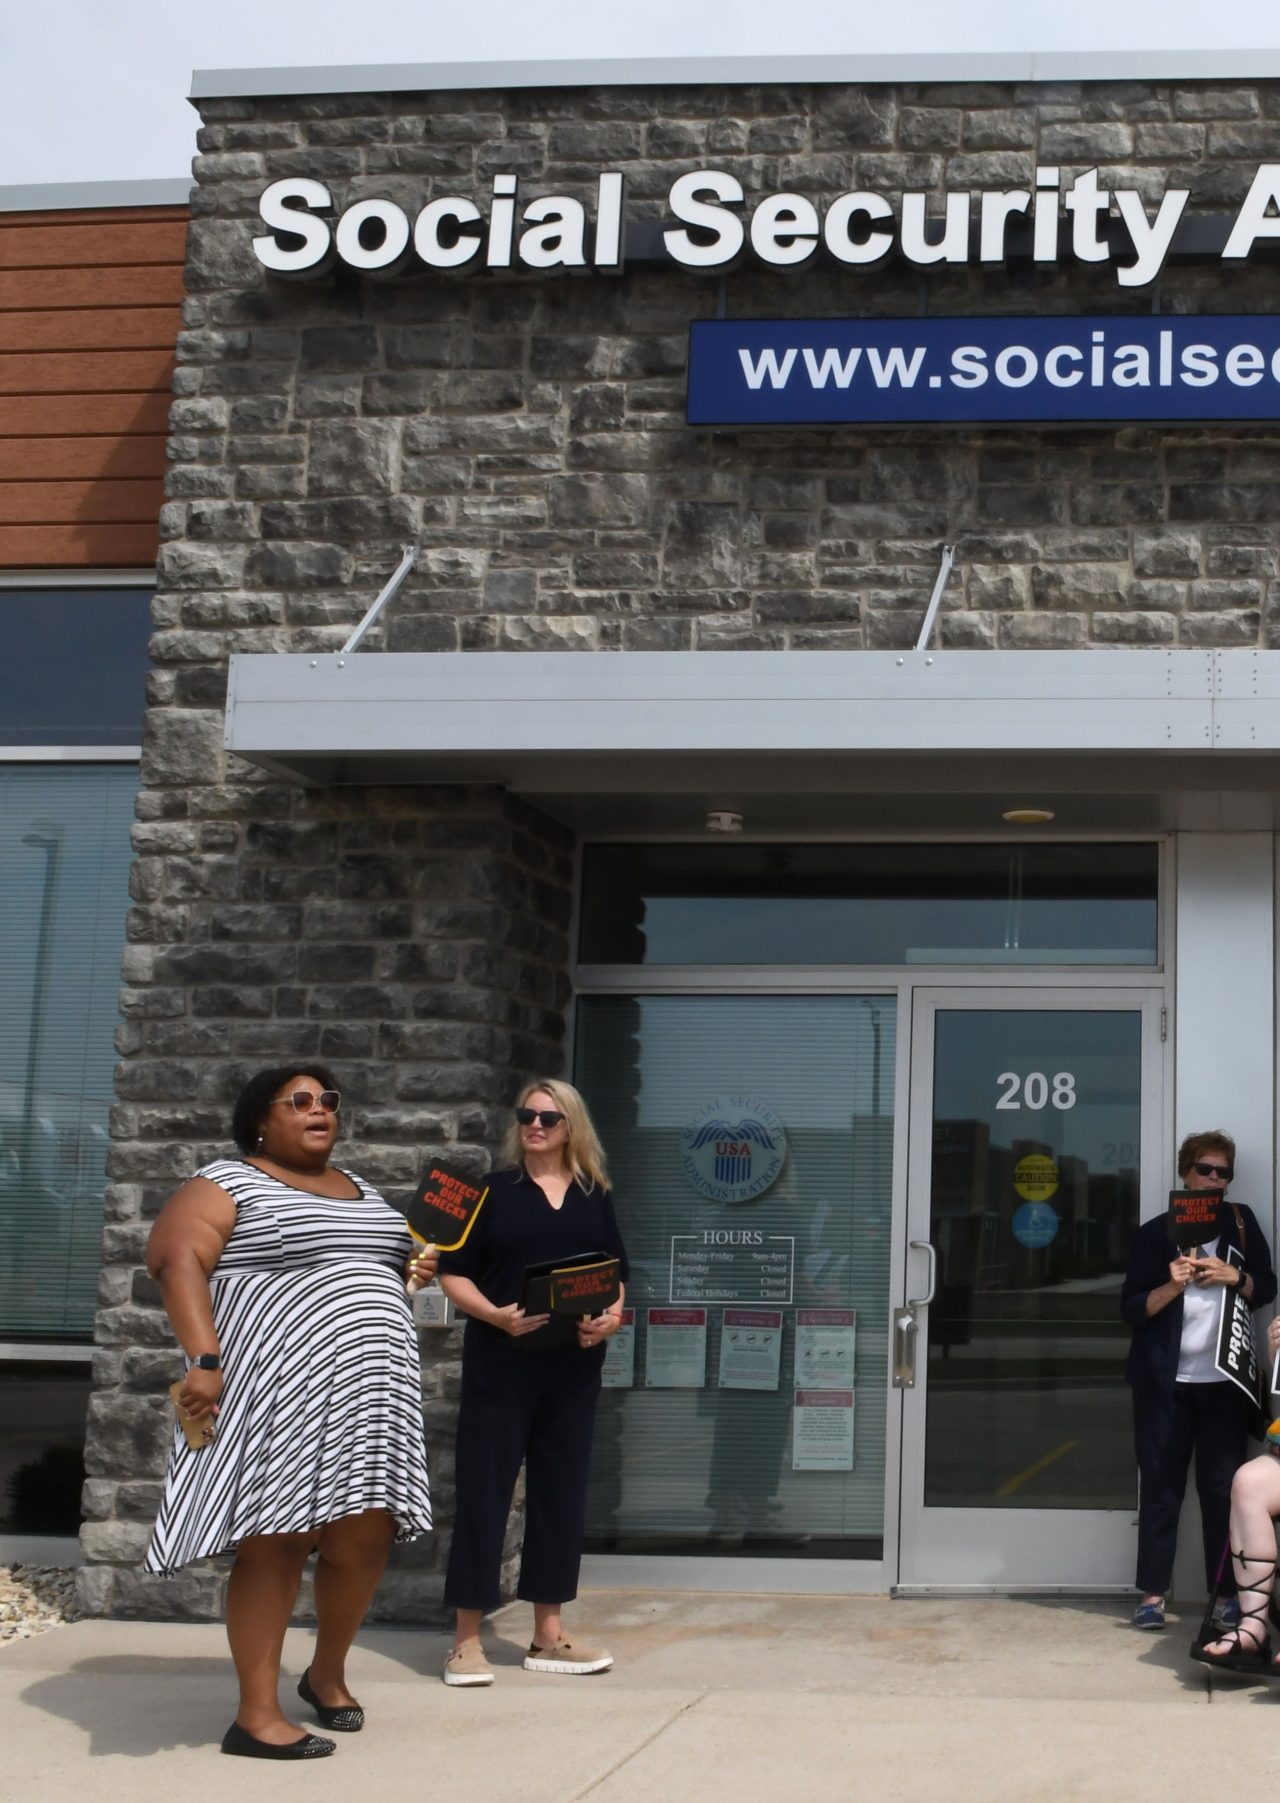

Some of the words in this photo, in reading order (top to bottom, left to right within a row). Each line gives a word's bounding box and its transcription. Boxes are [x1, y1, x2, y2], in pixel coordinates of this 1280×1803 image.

[252, 172, 622, 270] Social
[663, 167, 1189, 286] Security
[995, 1072, 1077, 1110] 208
[683, 1101, 720, 1139] SOCIAL
[730, 1096, 783, 1141] SECURITY
[715, 1142, 752, 1156] USA
[1103, 1142, 1140, 1165] 20
[430, 1169, 480, 1200] PROTECT
[683, 1156, 781, 1199] ADMINISTRATION
[1016, 1173, 1056, 1182] CAUTION
[440, 1186, 463, 1205] OUR
[1173, 1197, 1220, 1207] PROTECT
[424, 1191, 467, 1219] CHECKS
[1186, 1206, 1207, 1215] OUR
[1175, 1213, 1216, 1223] CHECKS
[703, 1230, 763, 1245] HOURS
[678, 1252, 734, 1262] Monday-Friday
[752, 1252, 787, 1262] 9am-4pm
[677, 1265, 710, 1274] Saturday
[761, 1265, 787, 1273] Closed
[557, 1269, 615, 1286] PROTECT
[677, 1277, 704, 1286] Sunday
[760, 1277, 786, 1285] Closed
[562, 1284, 612, 1298] CHECKS
[676, 1289, 703, 1298] Federal
[706, 1289, 738, 1299] Holidays
[760, 1290, 786, 1298] Closed
[1227, 1293, 1245, 1371] PROTE
